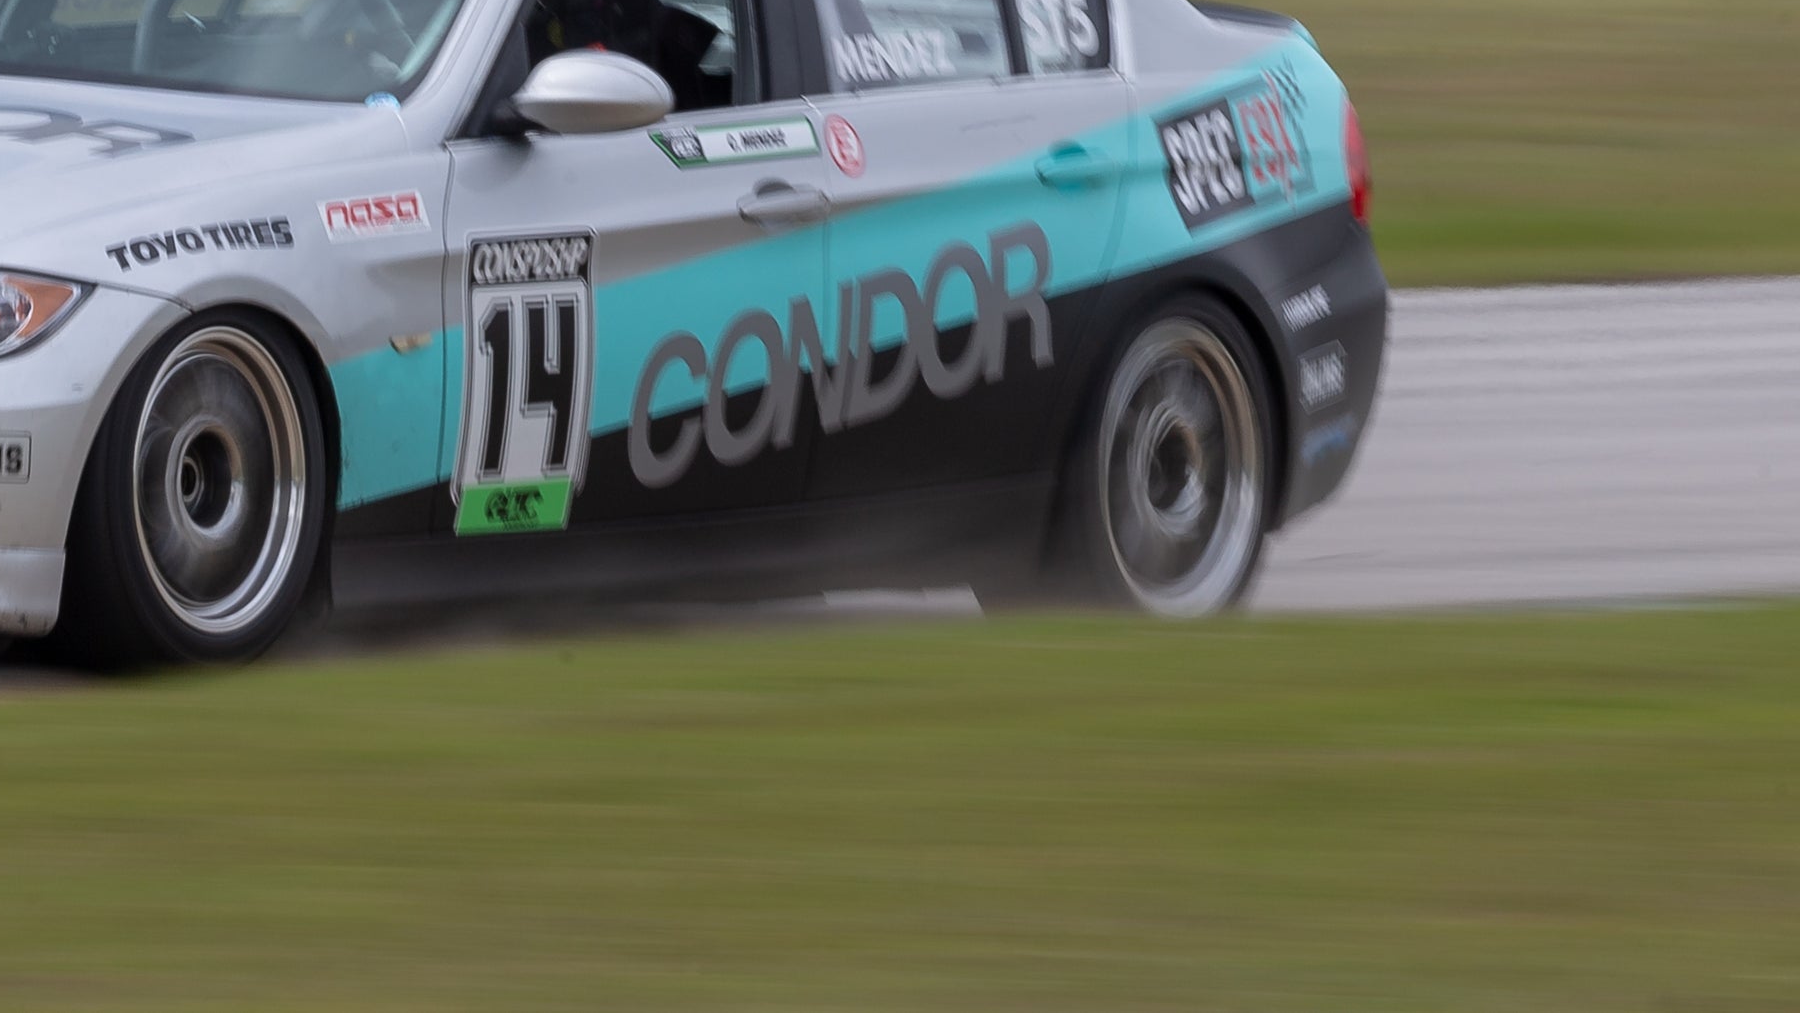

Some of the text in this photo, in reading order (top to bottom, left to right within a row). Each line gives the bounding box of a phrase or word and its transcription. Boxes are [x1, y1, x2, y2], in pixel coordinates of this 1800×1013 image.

[832, 28, 957, 83] MENDEZ
[1162, 107, 1248, 217] SPEC
[105, 227, 206, 273] TOYO
[200, 216, 295, 251] TIRES
[477, 293, 582, 484] 14
[628, 221, 1054, 489] CONDOR
